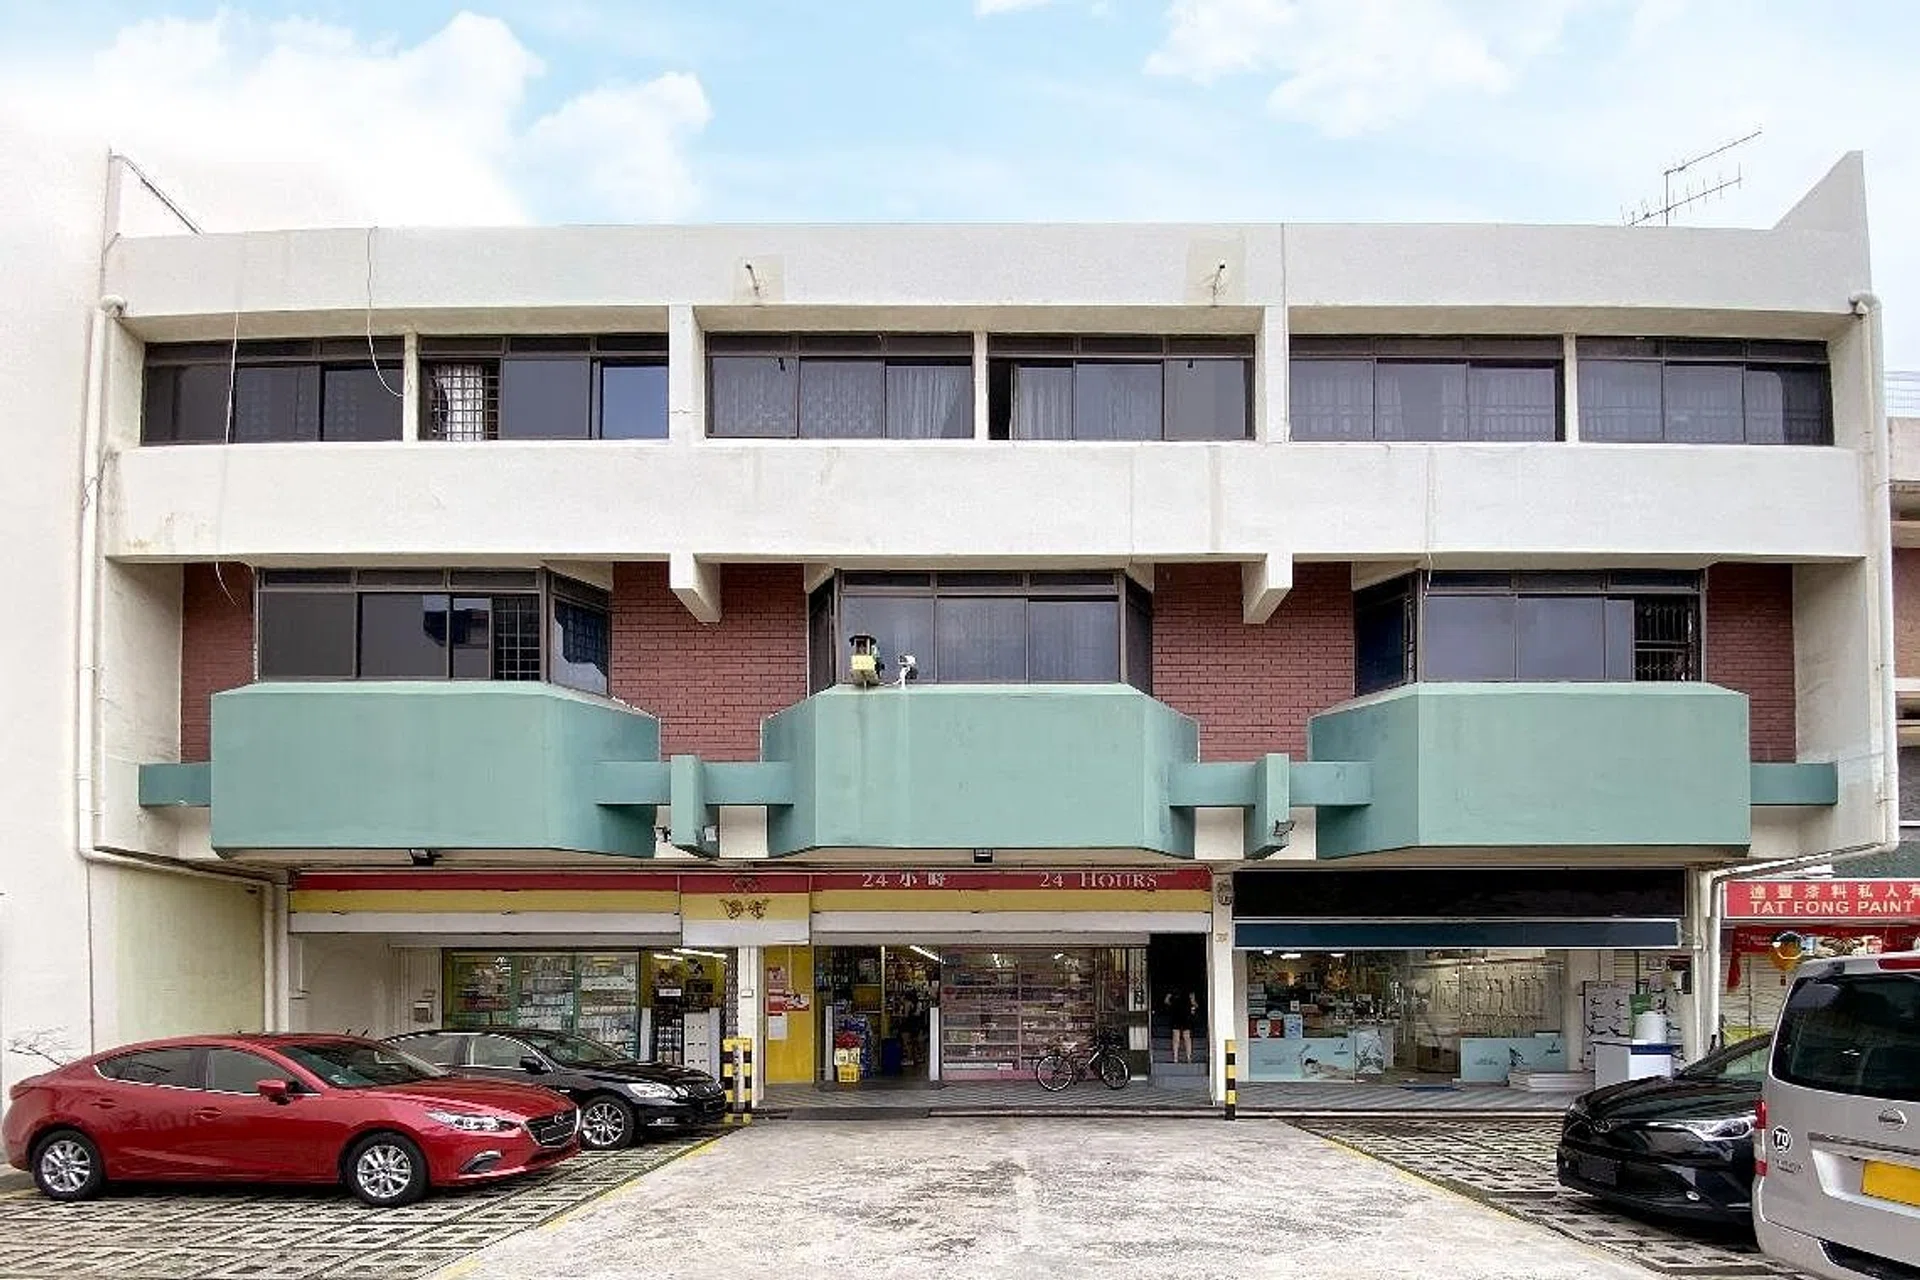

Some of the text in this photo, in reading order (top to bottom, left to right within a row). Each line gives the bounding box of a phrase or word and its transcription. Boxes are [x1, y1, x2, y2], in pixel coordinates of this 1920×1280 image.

[862, 872, 888, 887] 24
[1040, 872, 1157, 887] 24 HOURS
[1751, 900, 1914, 914] TAT FONG PAINT
